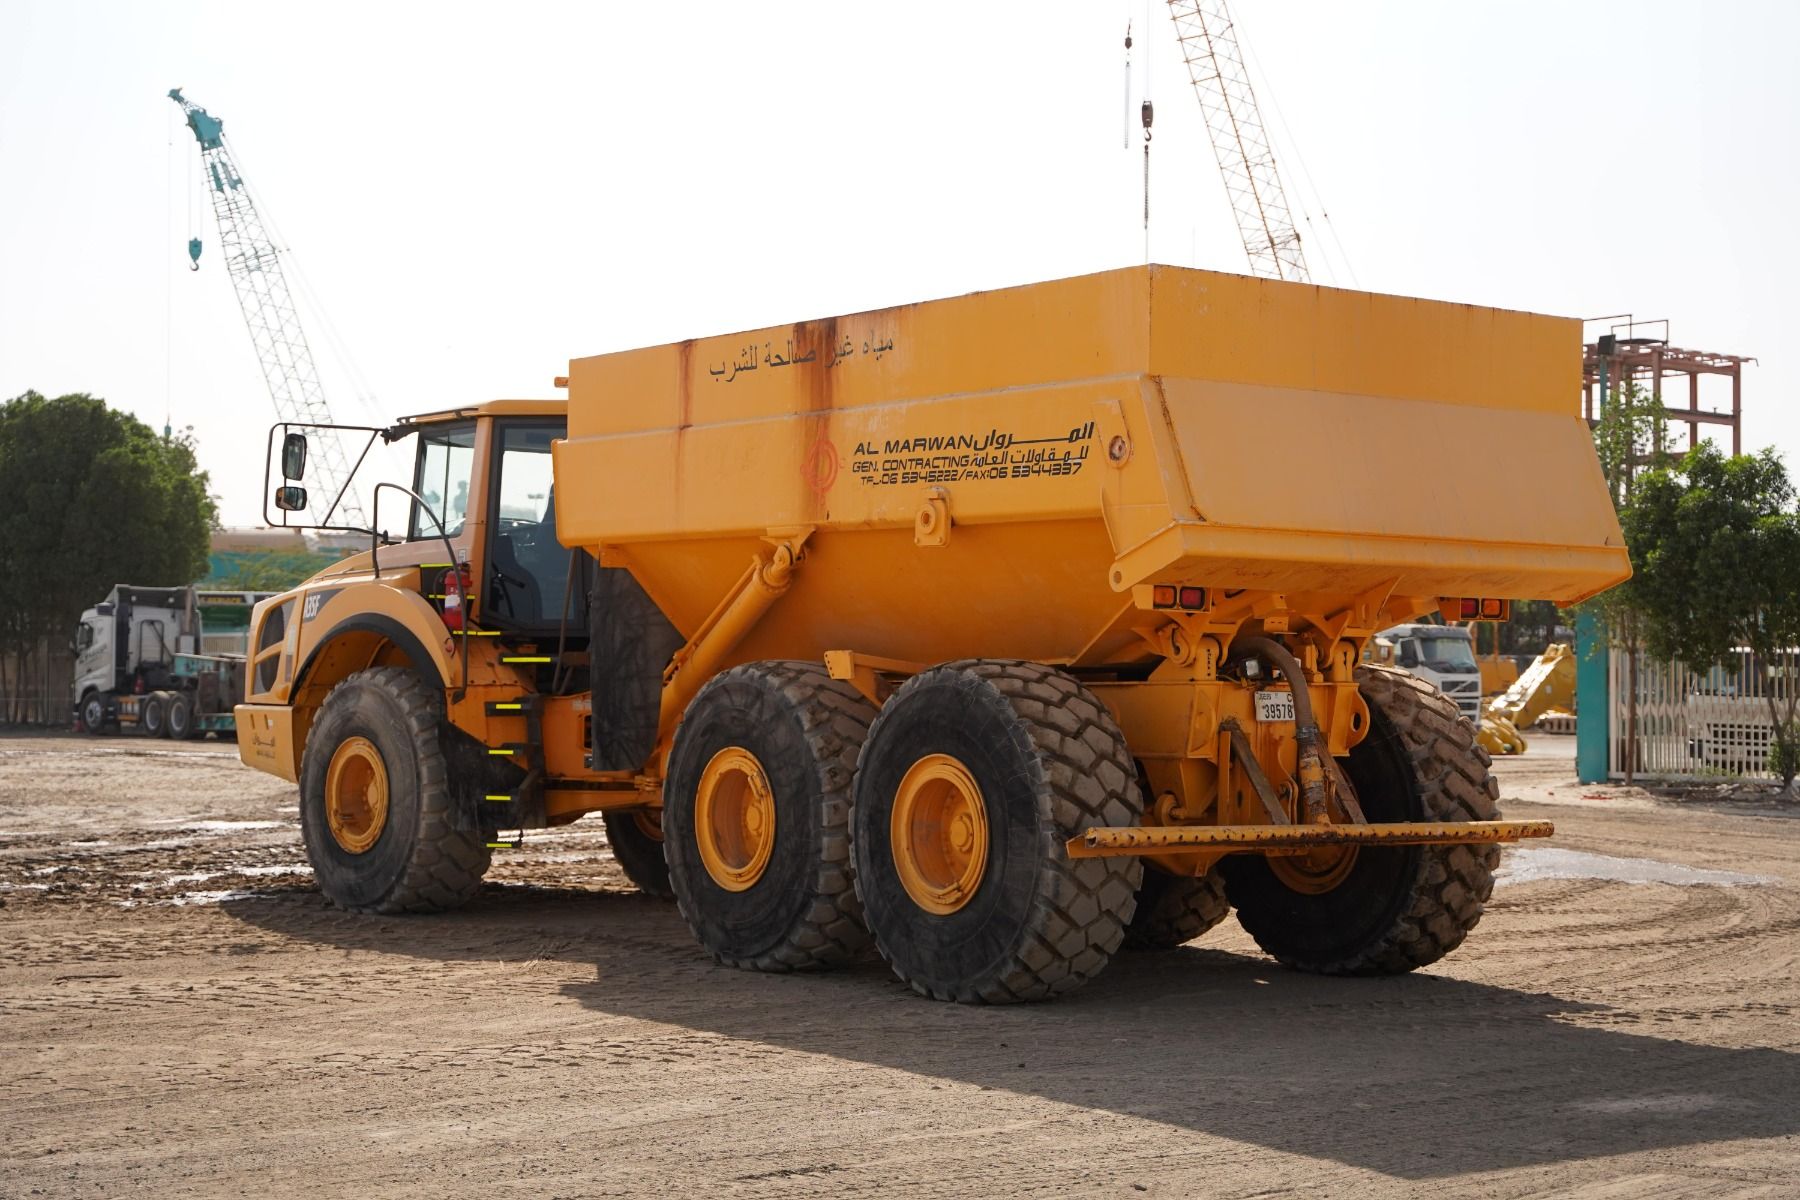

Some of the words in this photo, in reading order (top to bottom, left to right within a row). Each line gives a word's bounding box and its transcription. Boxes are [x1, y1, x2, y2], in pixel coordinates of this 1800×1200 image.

[764, 340, 817, 368] صالحة
[824, 335, 854, 369] غير
[863, 330, 893, 361] مياه
[709, 345, 758, 383] للشرب
[855, 442, 880, 456] AL
[884, 434, 974, 455] MARWAN
[1010, 445, 1089, 466] للمقاولات
[852, 461, 879, 473] GEN.
[882, 455, 970, 472] CONTRACTING
[970, 450, 1009, 468] العامة
[1011, 462, 1083, 479] 5344337
[1264, 703, 1293, 719] 39578
